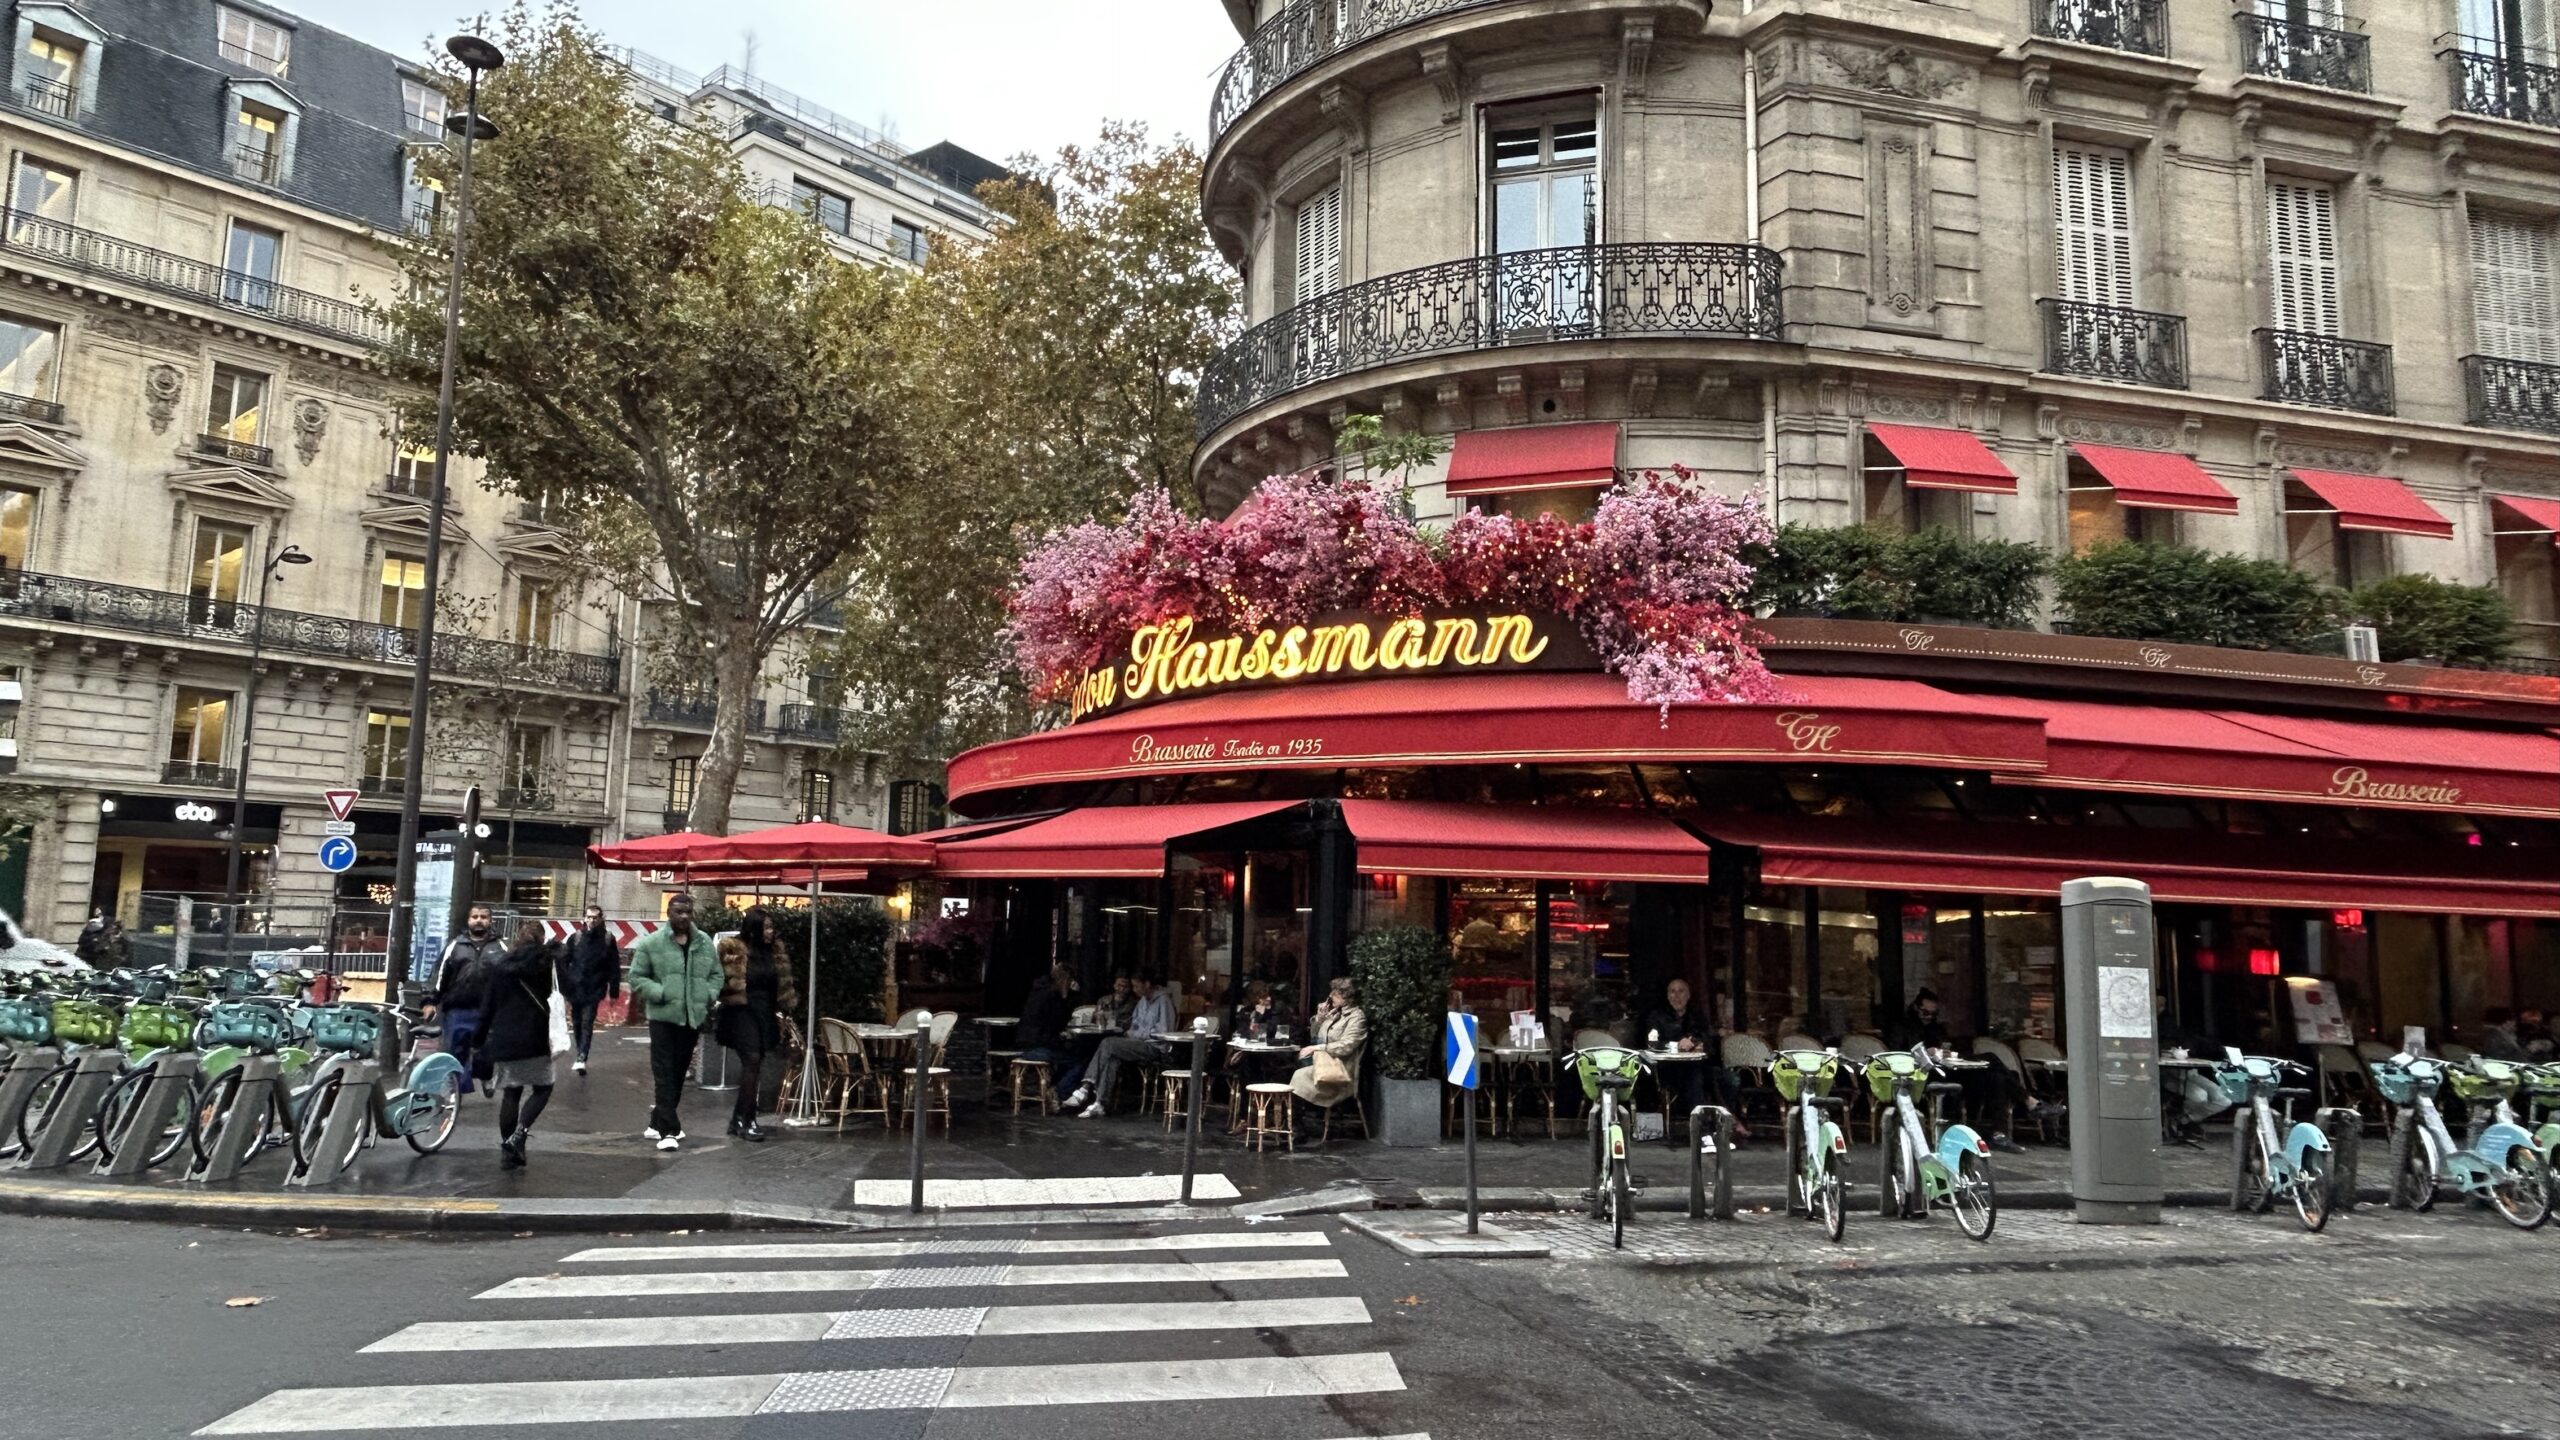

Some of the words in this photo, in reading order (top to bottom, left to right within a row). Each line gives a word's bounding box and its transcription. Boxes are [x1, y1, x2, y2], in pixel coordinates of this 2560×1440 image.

[1124, 614, 1548, 699] Haussmann
[1129, 734, 1216, 763] Brasserie
[1267, 745, 1281, 755] en
[1287, 738, 1323, 755] 1935
[2327, 766, 2462, 804] Brasserie
